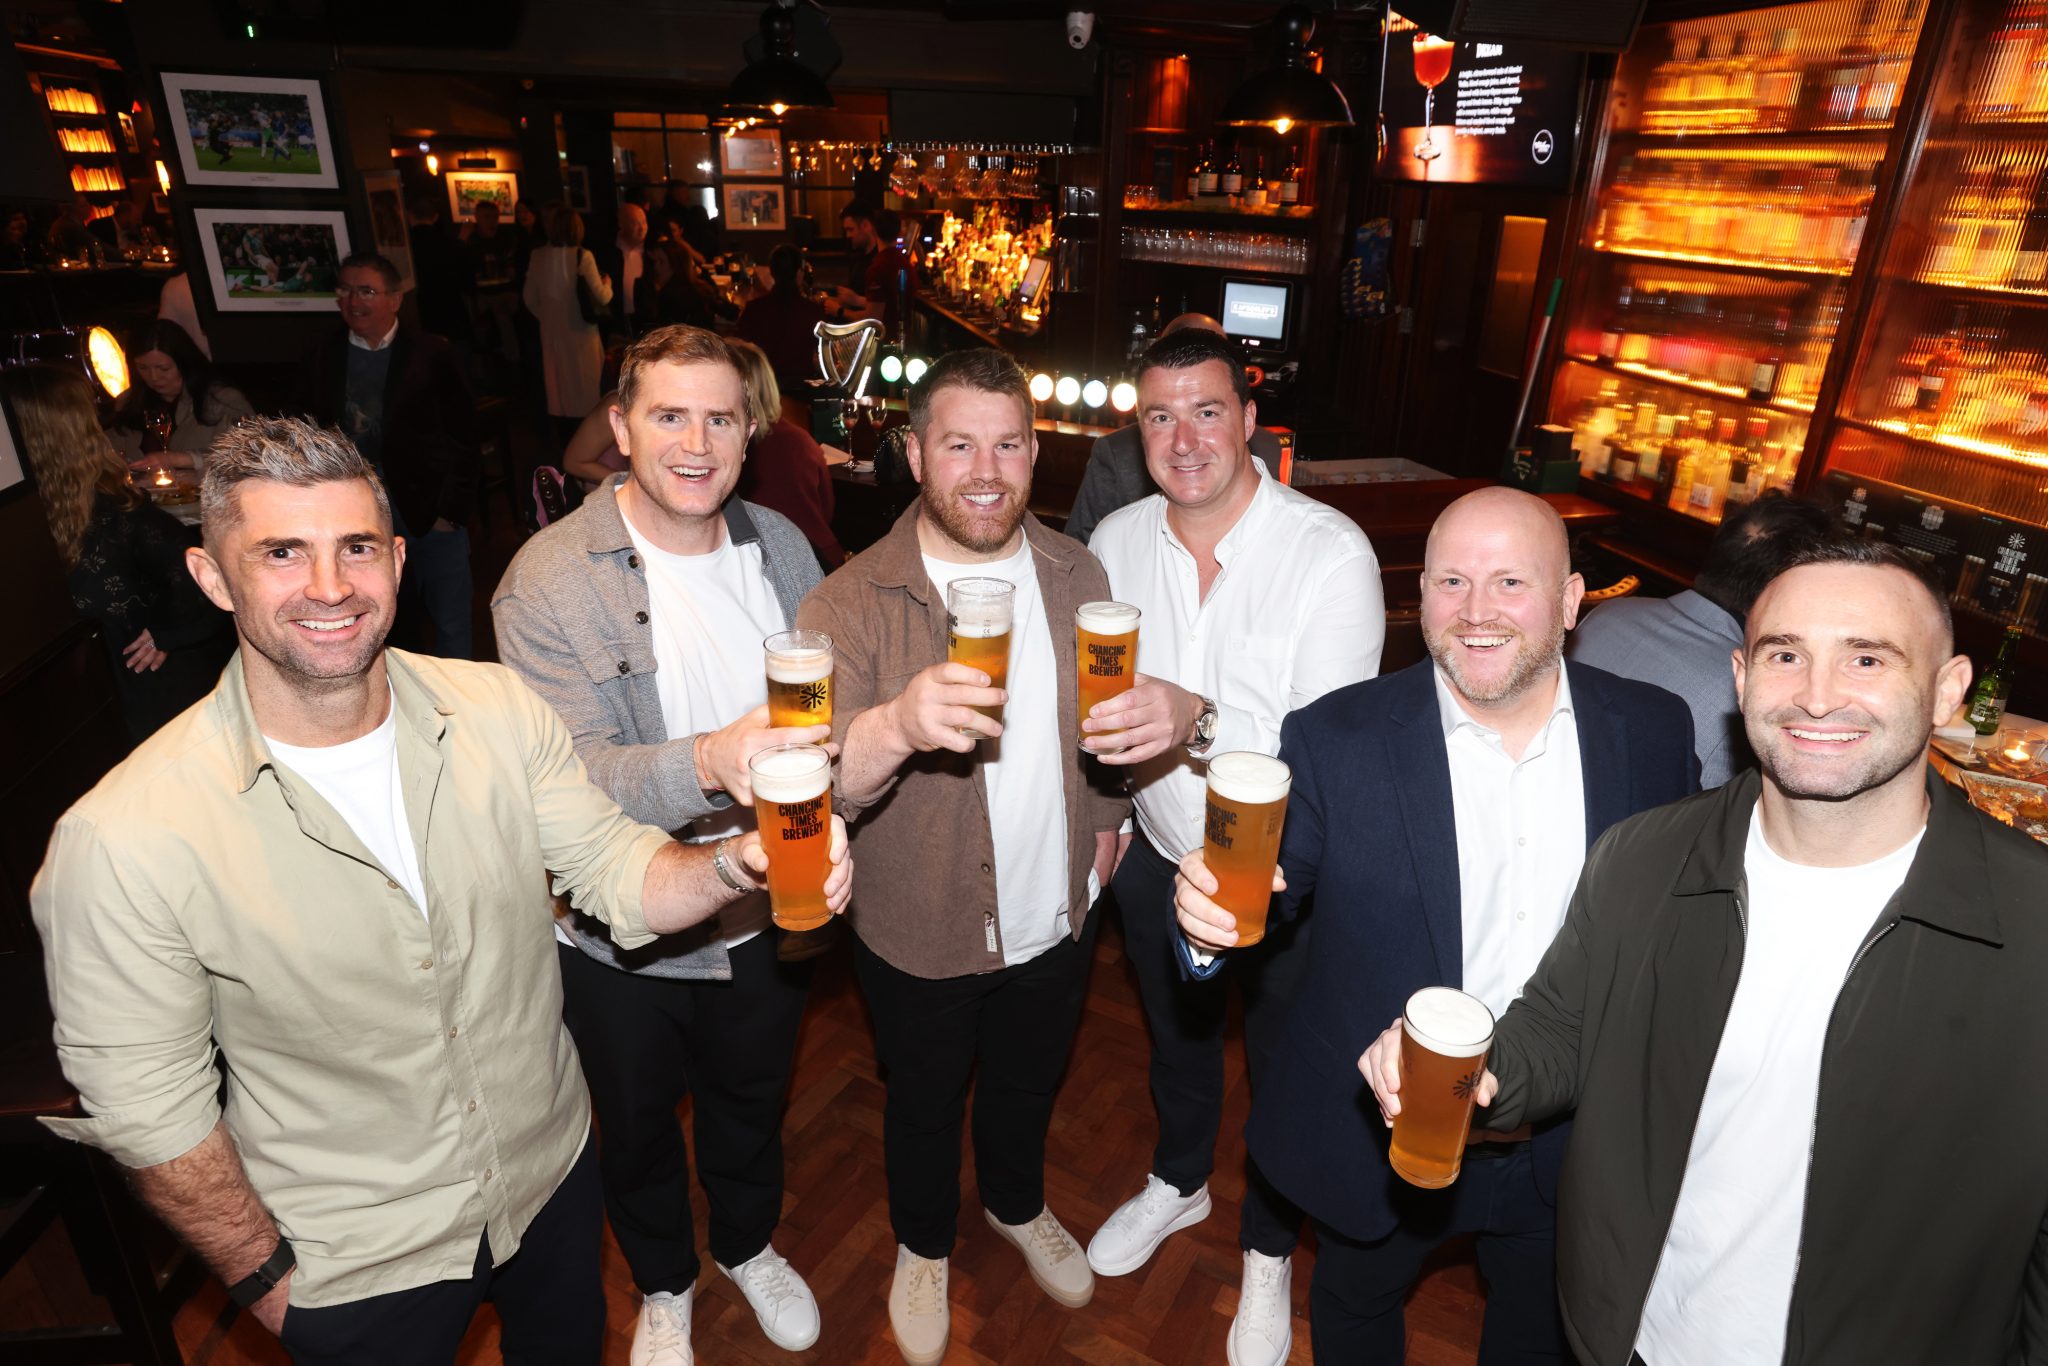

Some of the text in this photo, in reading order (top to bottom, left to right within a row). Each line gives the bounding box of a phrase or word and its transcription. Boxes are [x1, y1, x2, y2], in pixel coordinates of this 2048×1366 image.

[1095, 655, 1118, 666] TIMES
[1089, 664, 1123, 676] BREWERY
[789, 811, 818, 828] TIMES
[782, 821, 824, 840] BREWERY
